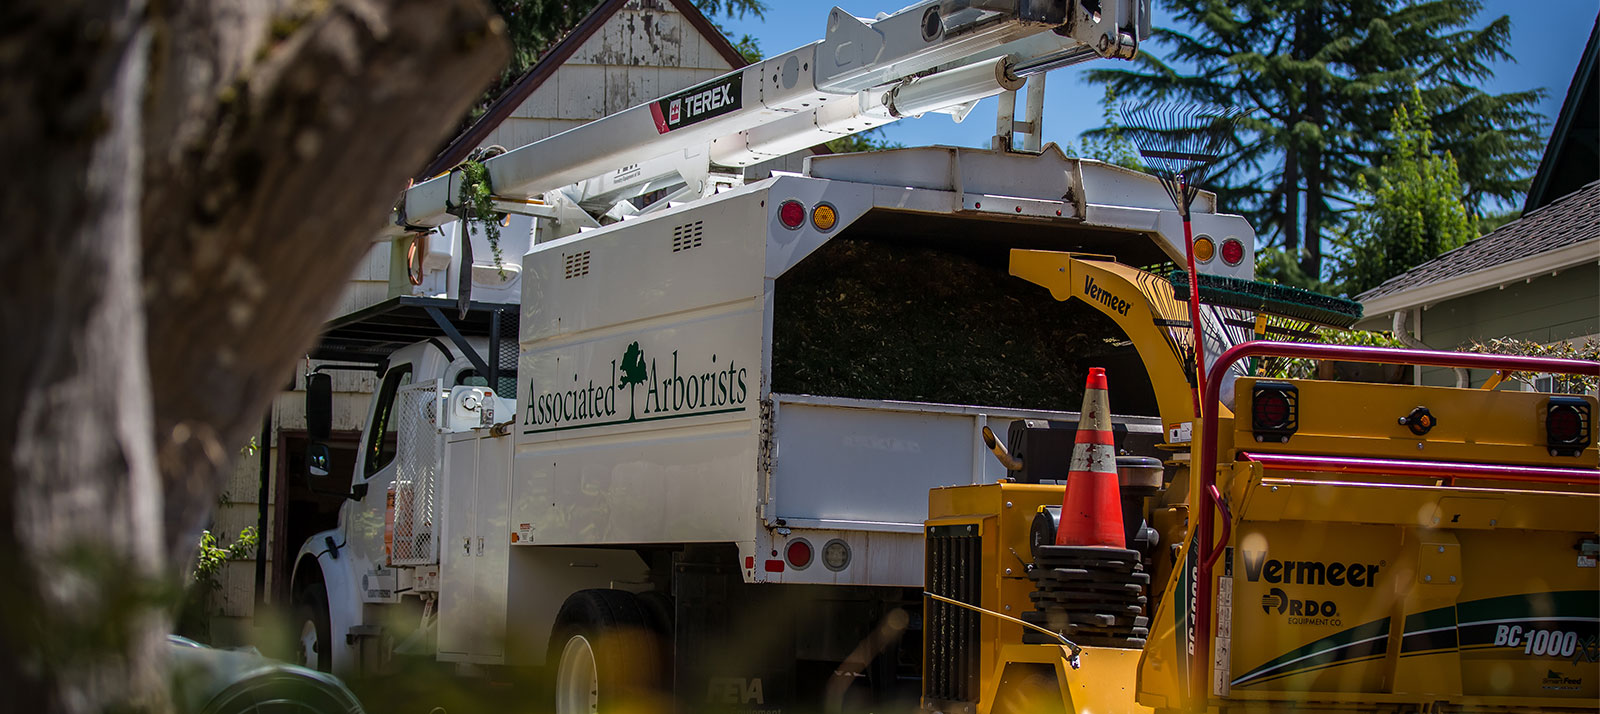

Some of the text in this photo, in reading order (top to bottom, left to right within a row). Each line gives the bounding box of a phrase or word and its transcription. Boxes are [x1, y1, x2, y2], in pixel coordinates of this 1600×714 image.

[685, 83, 731, 118] TEREX
[1084, 274, 1131, 317] Vermeer
[524, 350, 747, 426] Associated Arborists
[1242, 549, 1380, 588] Vermeer
[1288, 617, 1329, 626] EQUIPMENT
